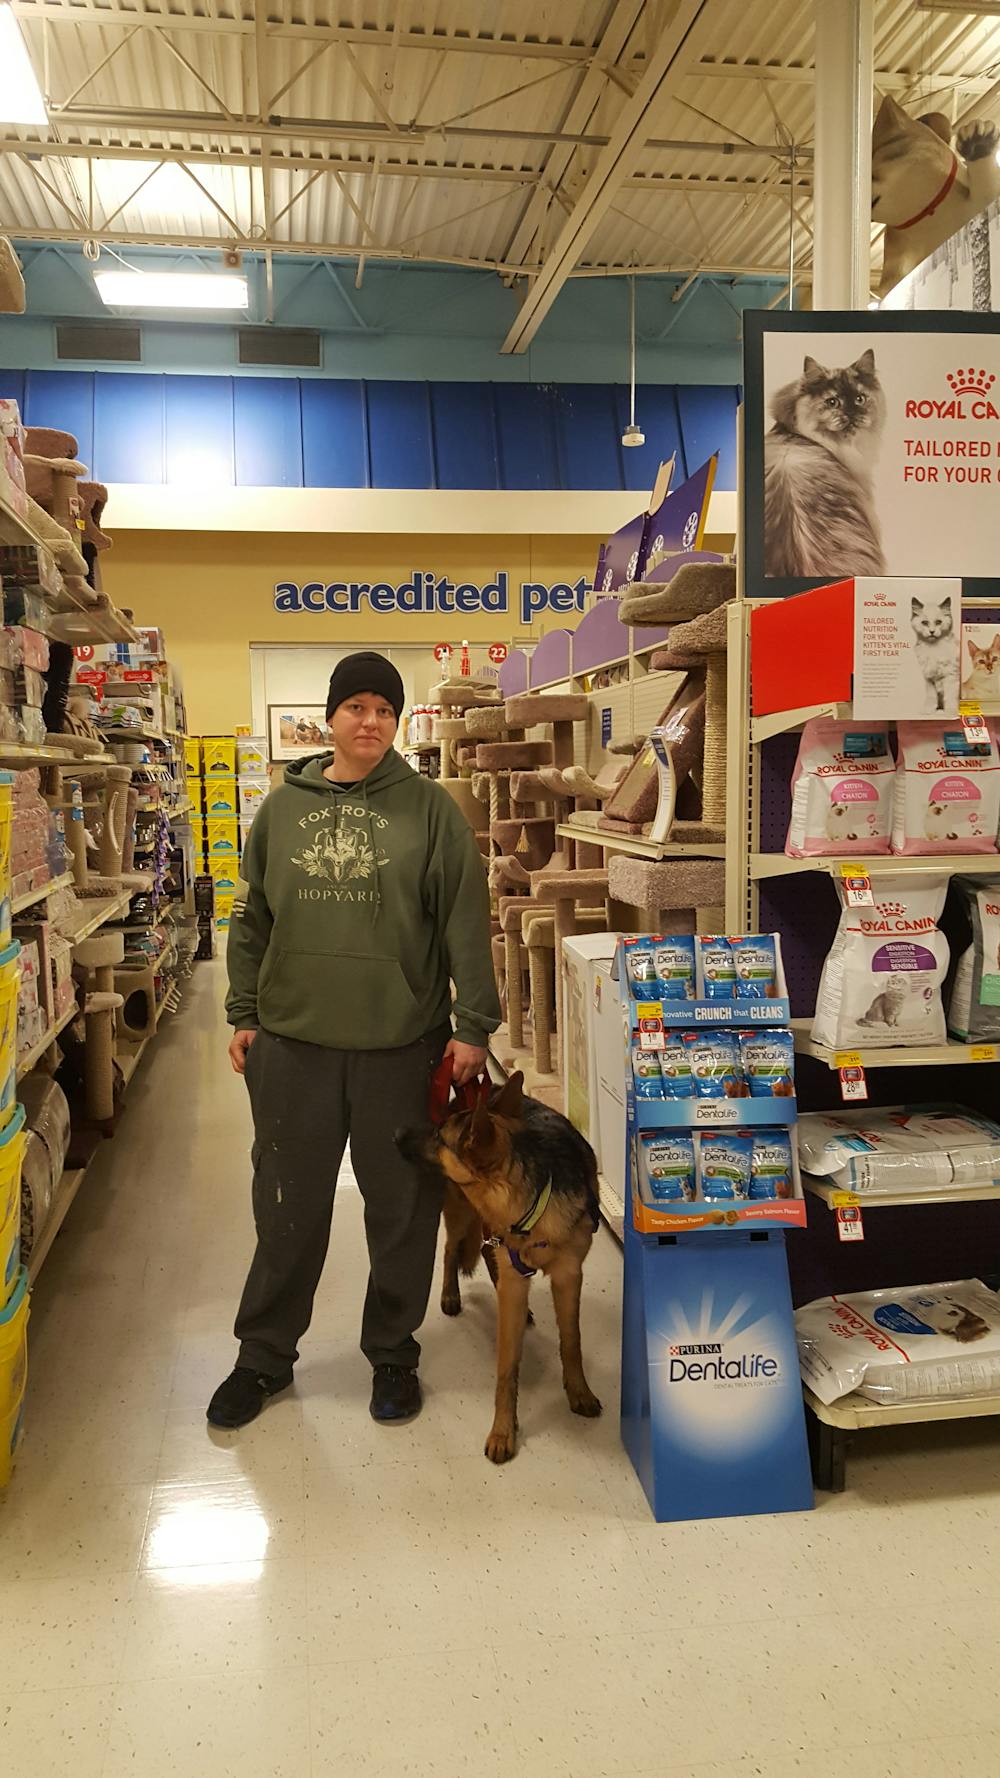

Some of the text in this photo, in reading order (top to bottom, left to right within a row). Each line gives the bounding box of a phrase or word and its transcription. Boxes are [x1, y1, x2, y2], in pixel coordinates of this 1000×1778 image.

[905, 400, 967, 420] ROYAL
[904, 440, 987, 457] TAILORED
[904, 466, 938, 483] FOR
[944, 466, 987, 484] YOUR
[274, 570, 508, 613] accredited
[76, 645, 91, 657] 19
[491, 647, 506, 659] 22
[817, 763, 879, 774] ROYAL CANIN
[917, 759, 982, 770] ROYAL CANIN
[298, 804, 389, 829] FOXROT'S
[895, 916, 937, 931] CANIN
[695, 1007, 732, 1021] CRUNCH
[733, 1009, 749, 1017] that
[750, 1005, 784, 1020] CLEANS
[680, 1344, 721, 1355] PURINA
